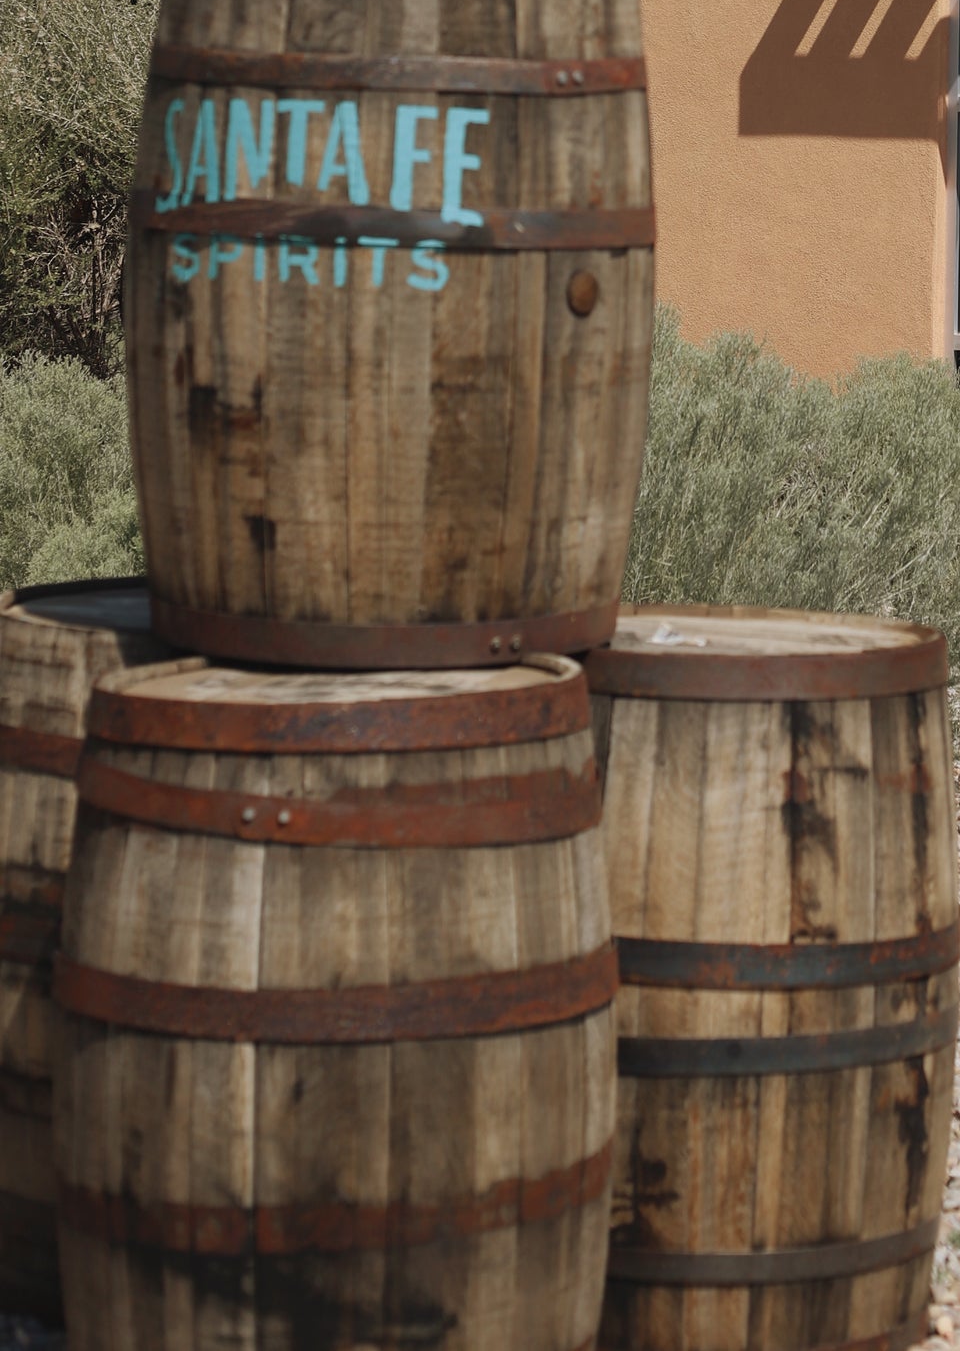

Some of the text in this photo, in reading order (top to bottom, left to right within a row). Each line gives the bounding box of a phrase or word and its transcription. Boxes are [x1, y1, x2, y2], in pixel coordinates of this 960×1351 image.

[156, 98, 490, 227] SANTA FE
[171, 233, 450, 291] SPIRITS
